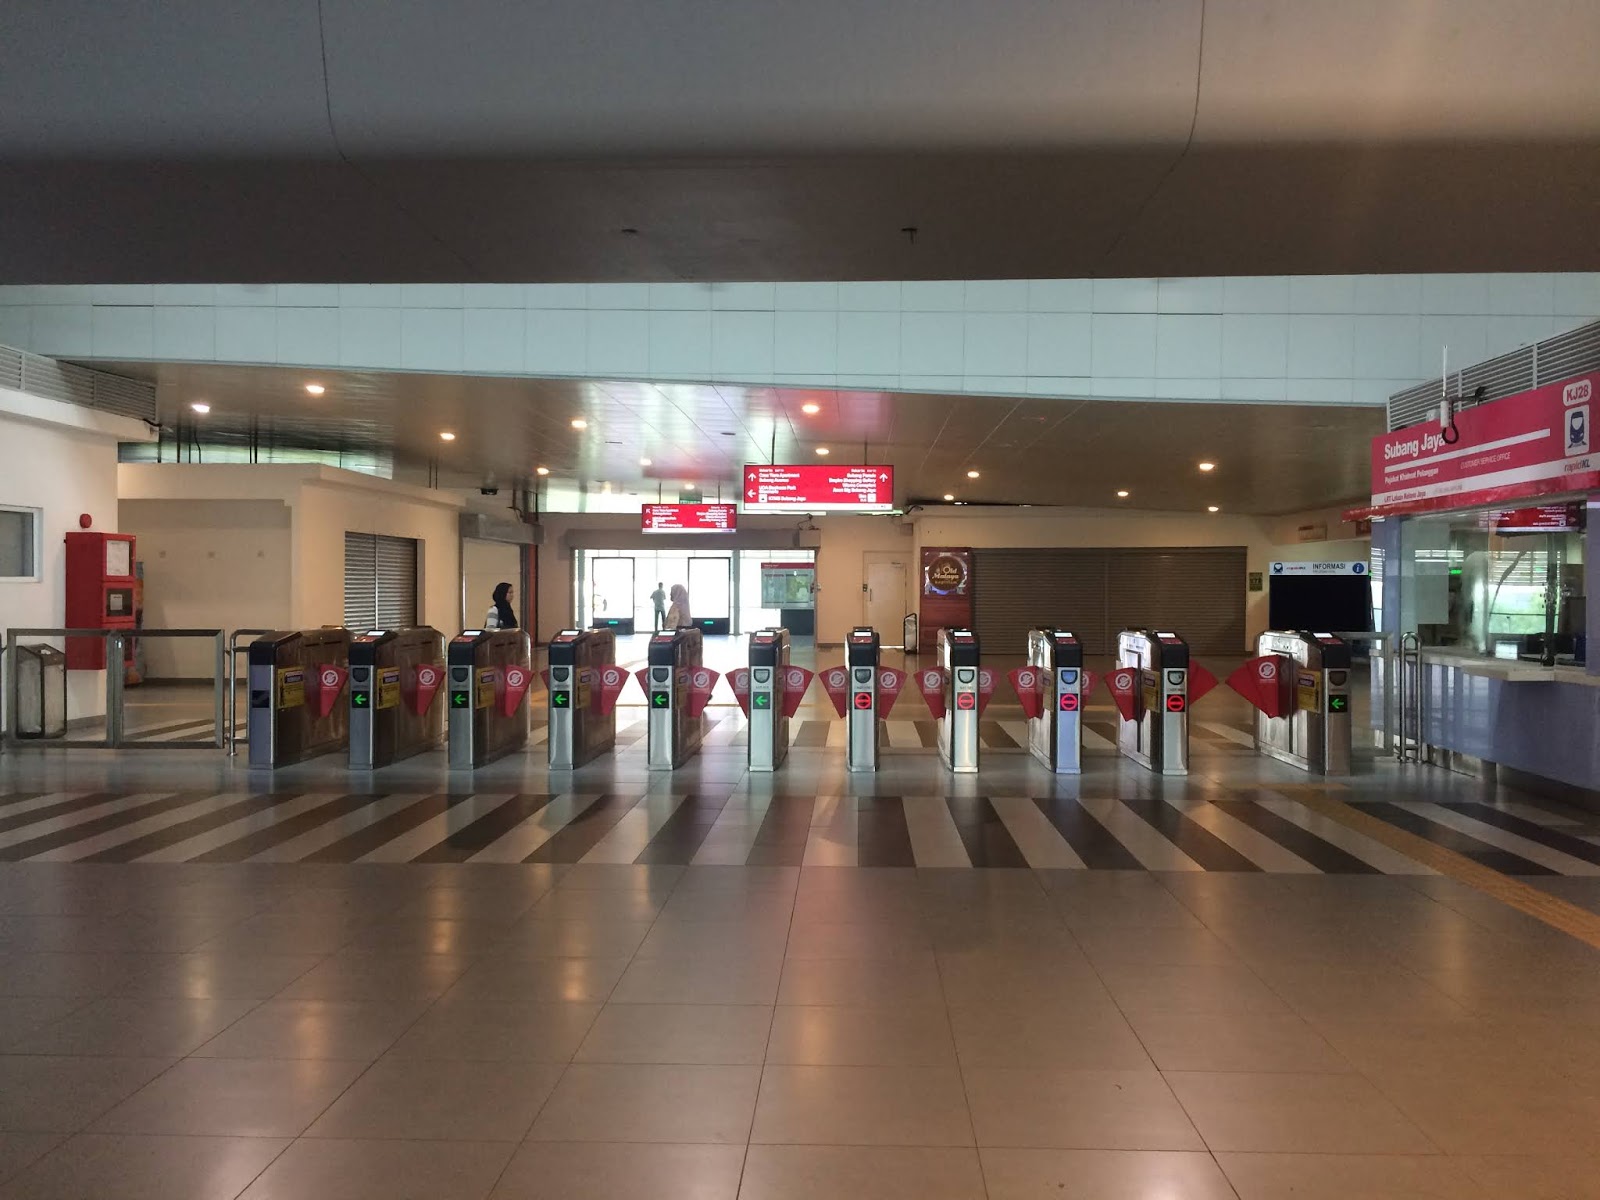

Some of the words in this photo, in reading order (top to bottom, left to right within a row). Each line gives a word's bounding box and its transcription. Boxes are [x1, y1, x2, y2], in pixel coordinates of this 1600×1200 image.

[1566, 384, 1589, 402] KJ28
[1384, 440, 1419, 460] Subang
[1421, 433, 1446, 453] Jaya
[1564, 459, 1591, 472] rapidKL
